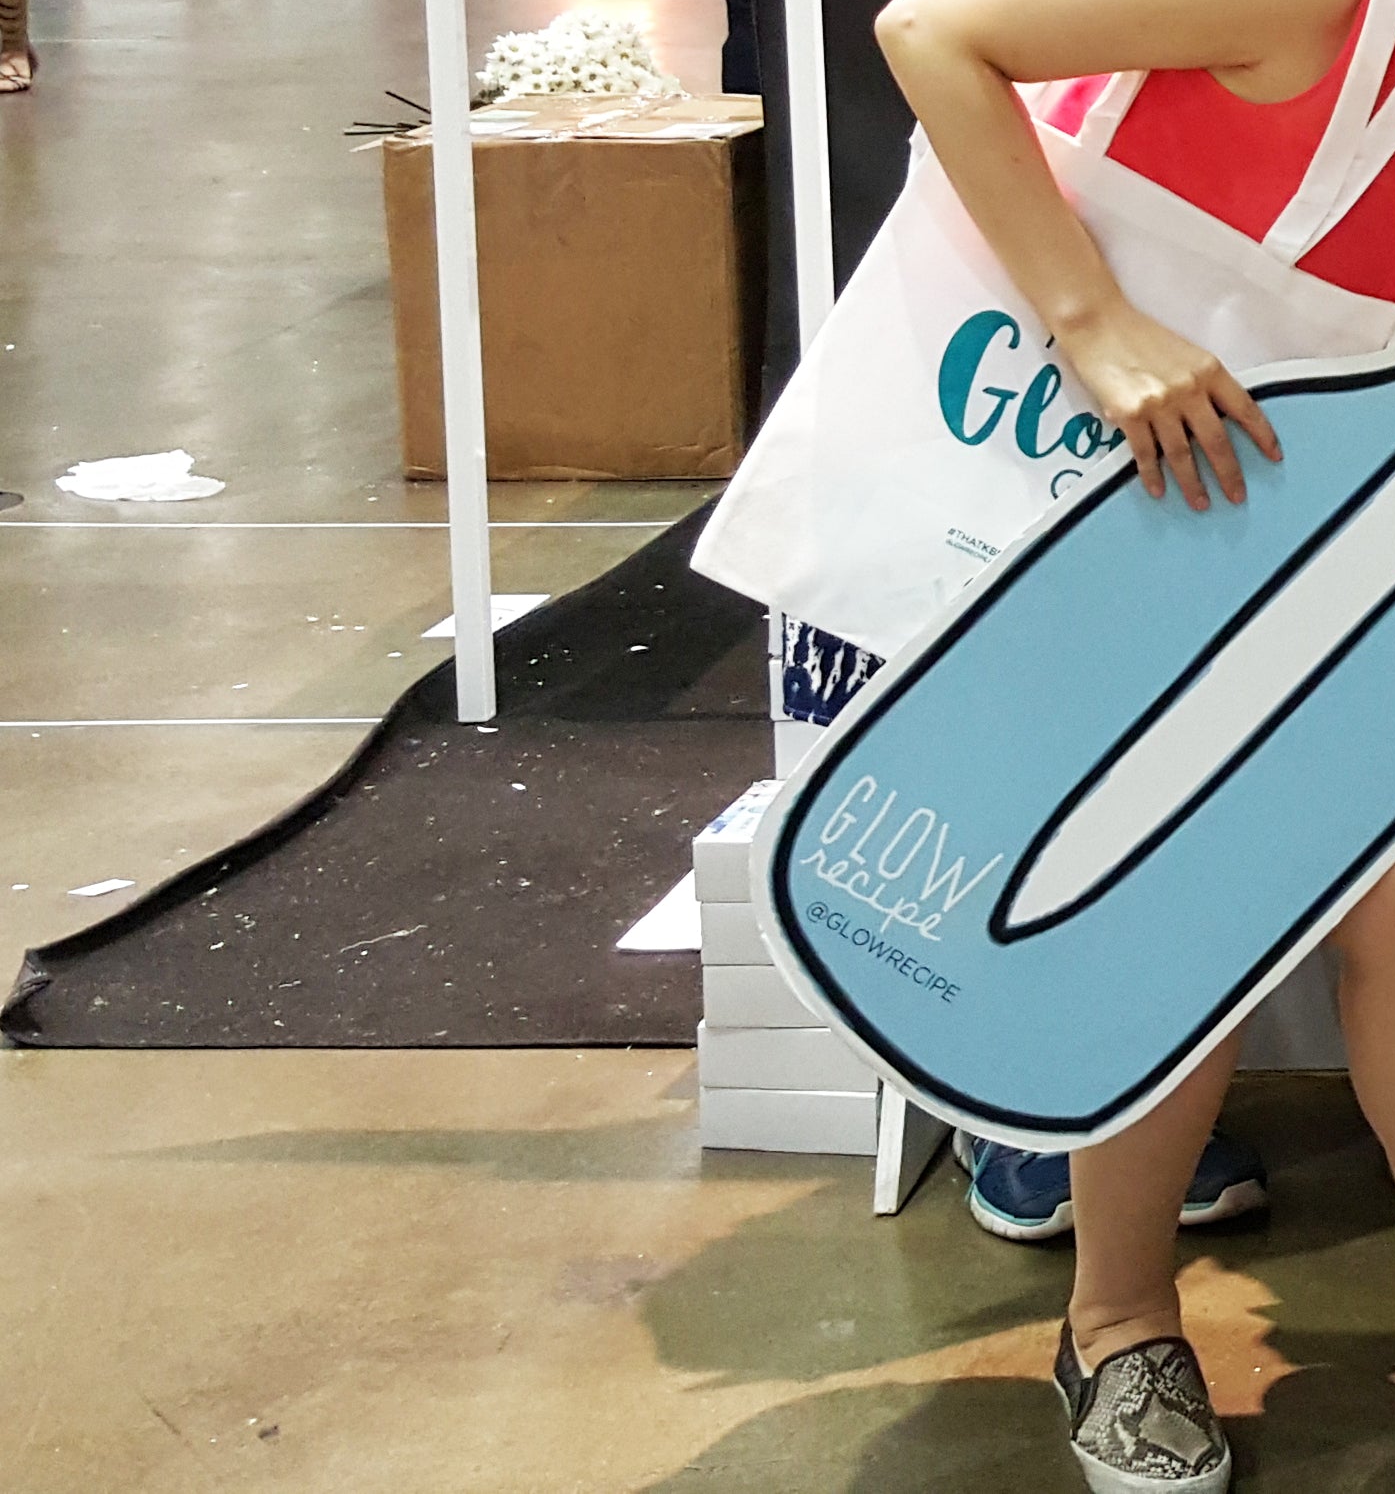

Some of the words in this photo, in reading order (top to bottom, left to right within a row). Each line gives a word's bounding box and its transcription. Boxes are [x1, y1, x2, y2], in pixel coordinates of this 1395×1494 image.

[800, 848, 941, 941] recipe
[819, 774, 1005, 913] GLOW
[806, 900, 962, 1004] @GLOWRECIPE
